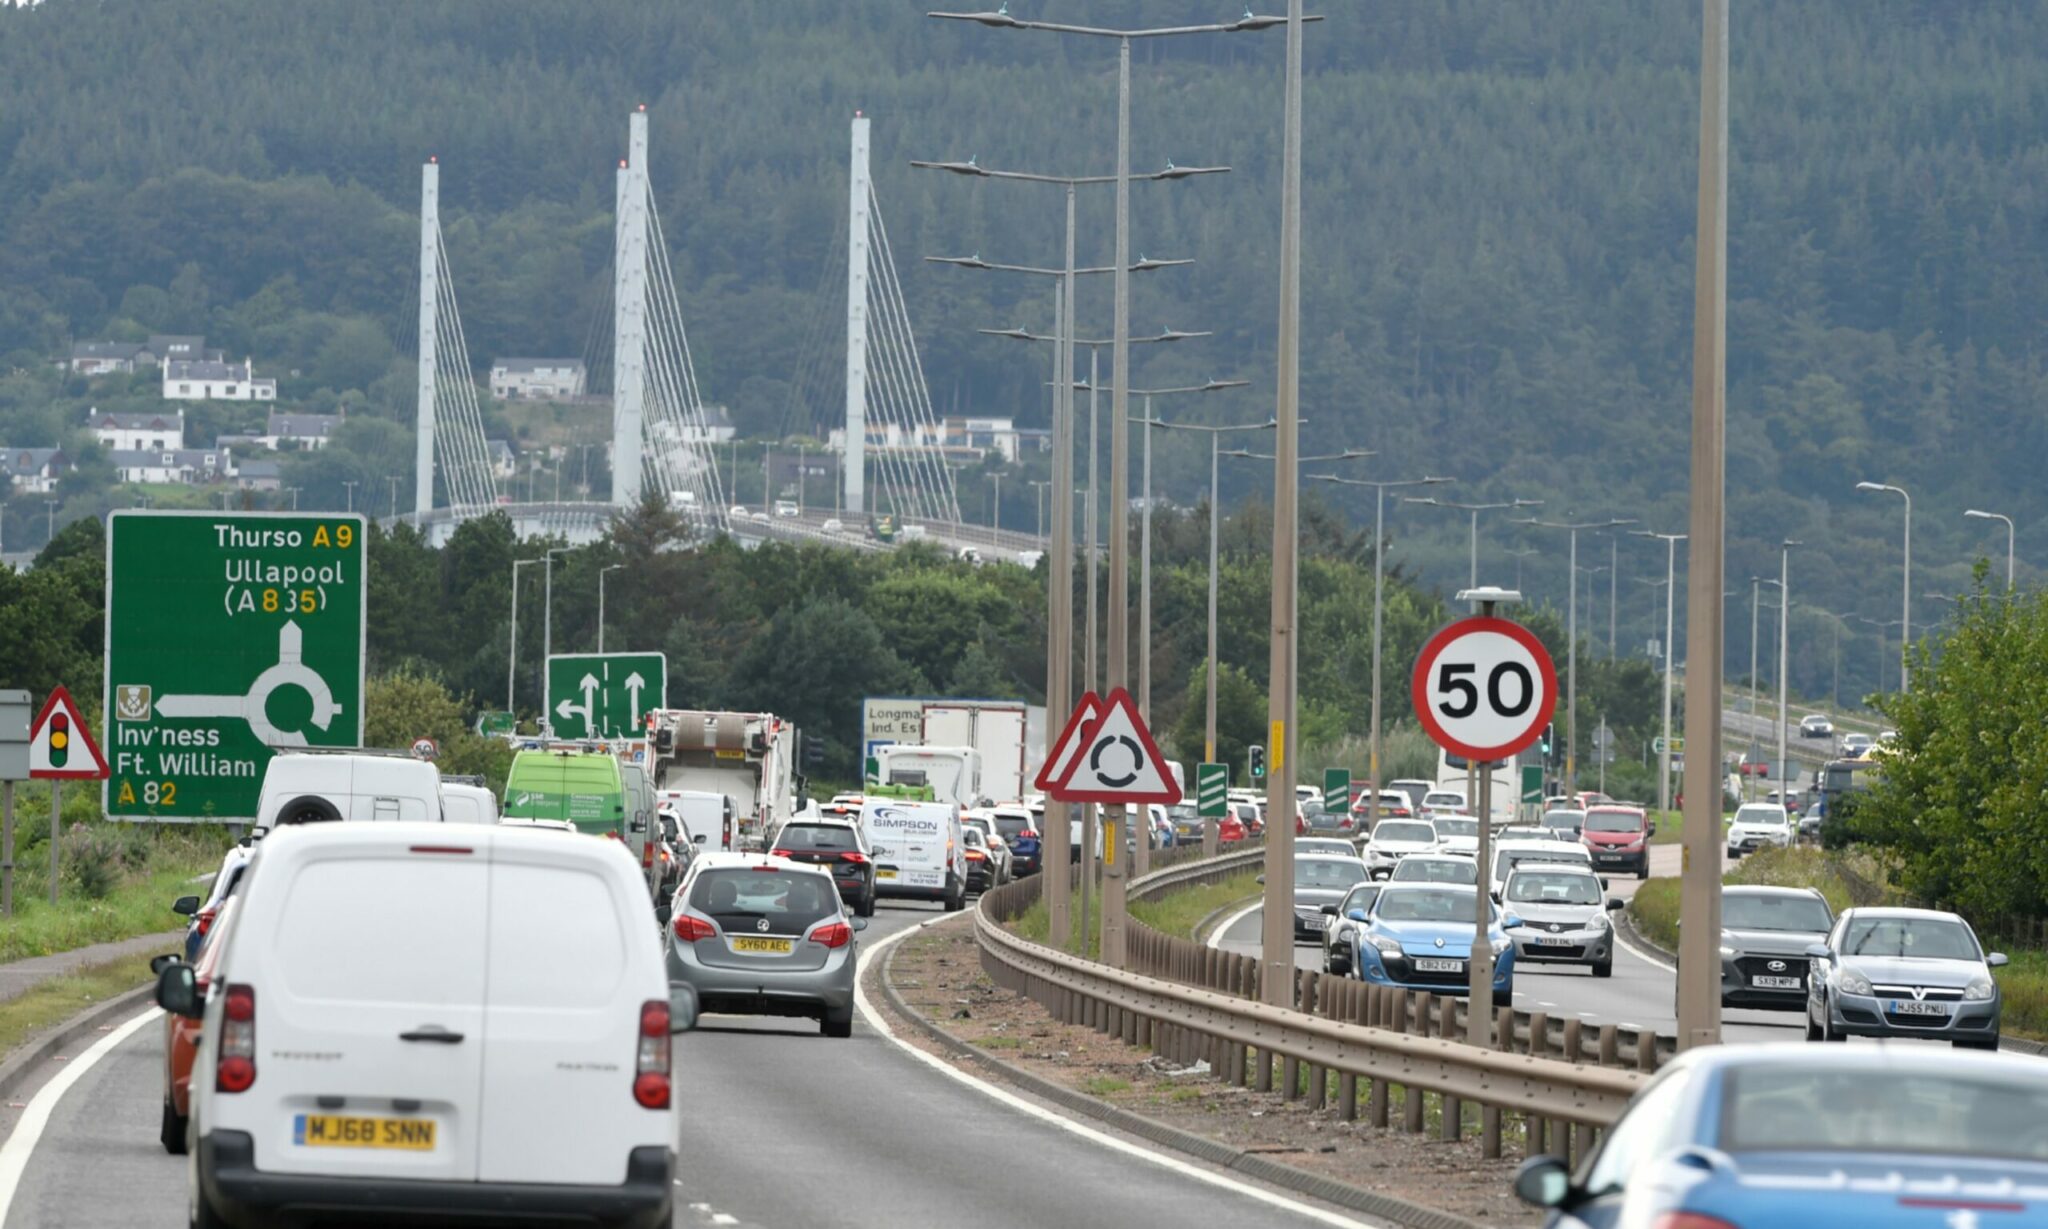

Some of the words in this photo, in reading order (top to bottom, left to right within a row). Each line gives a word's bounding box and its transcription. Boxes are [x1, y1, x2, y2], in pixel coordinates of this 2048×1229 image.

[214, 524, 302, 548] Thurso
[225, 560, 344, 588] Ullapool
[1438, 661, 1534, 719] 50
[117, 723, 220, 747] Inv'ness
[872, 722, 895, 733] Ind.
[117, 753, 151, 776] Ft.
[159, 753, 256, 777] William
[873, 819, 938, 830] SIMPSON
[740, 939, 768, 950] SY60
[770, 940, 790, 951] AEC
[1897, 1002, 1923, 1013] HJ55
[1925, 1003, 1944, 1014] PNU
[310, 1118, 376, 1142] MJ68
[383, 1120, 432, 1144] SNN
